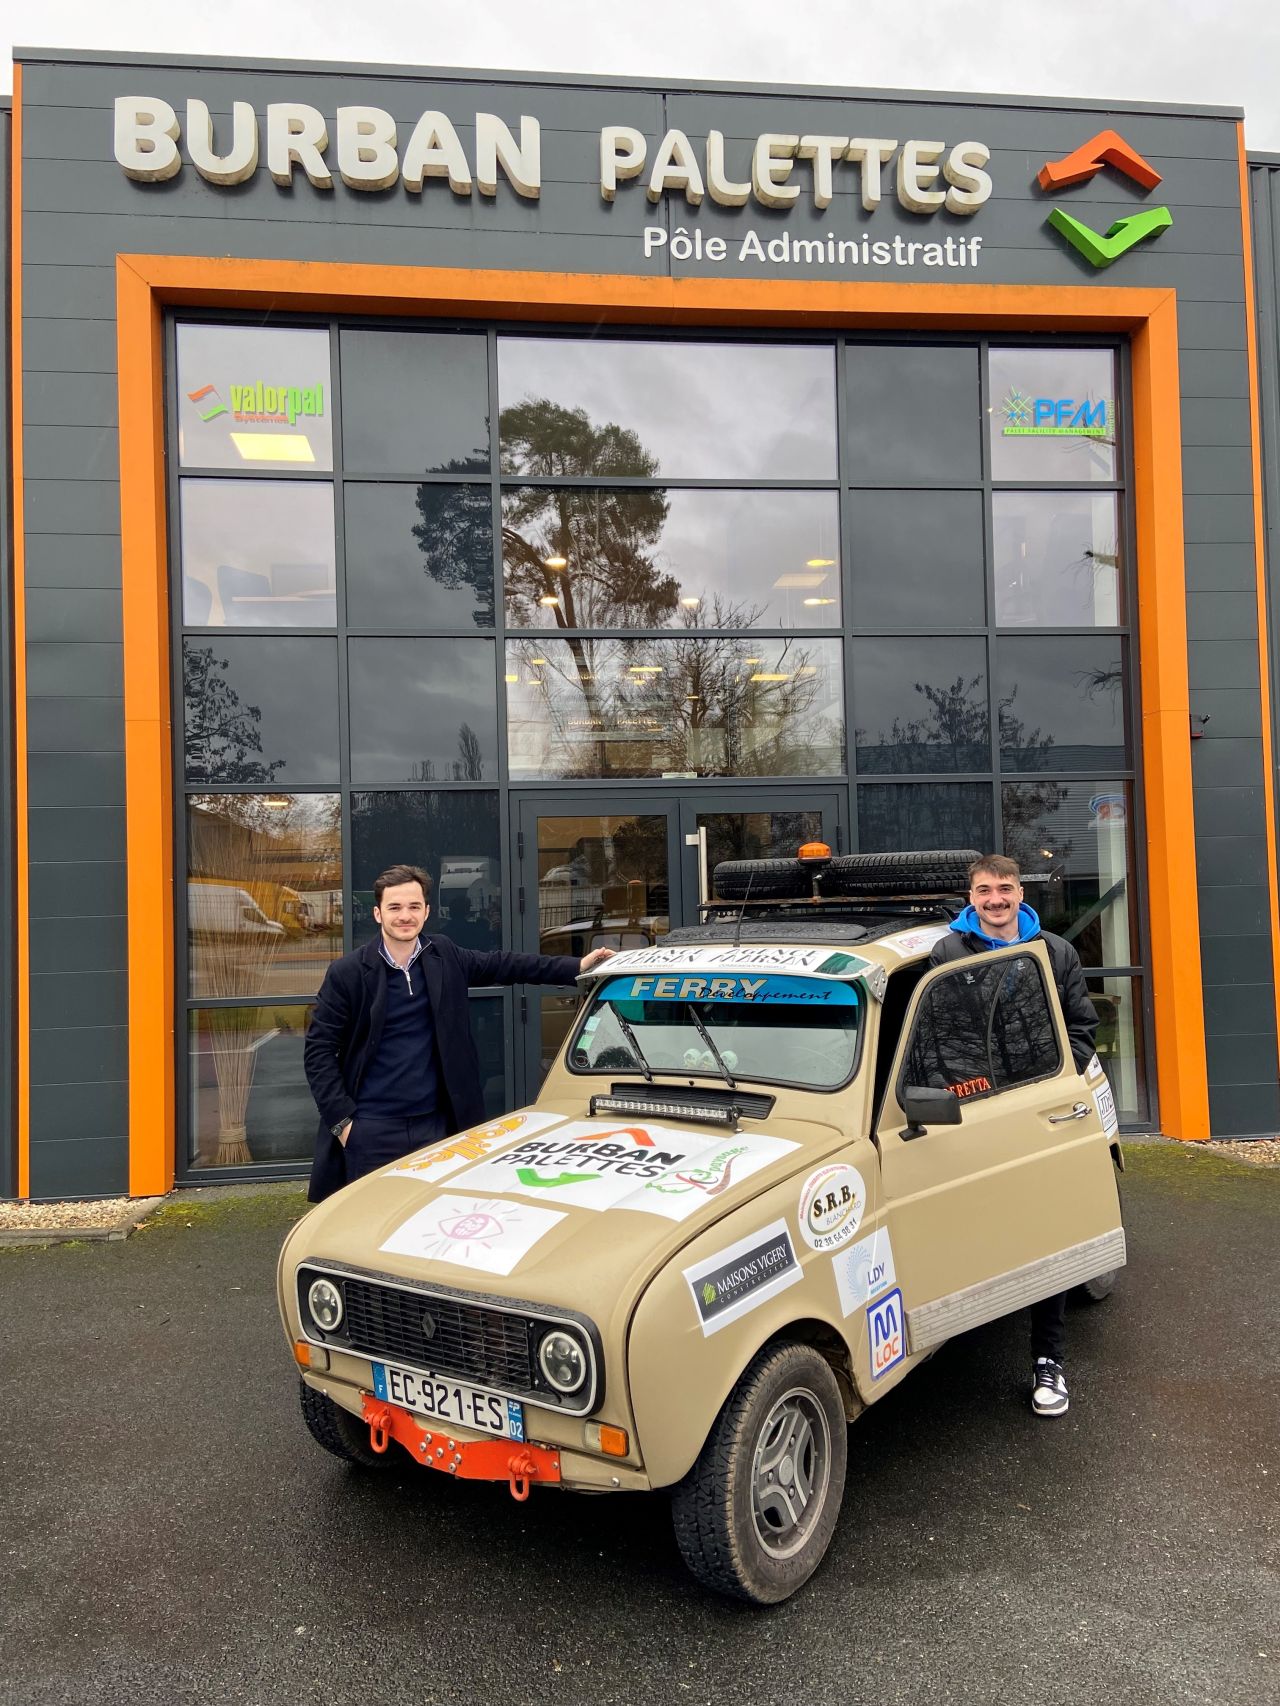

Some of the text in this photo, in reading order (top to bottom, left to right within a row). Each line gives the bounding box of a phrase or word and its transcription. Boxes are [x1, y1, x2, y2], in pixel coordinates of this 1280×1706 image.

[115, 96, 993, 214] BURBAN PALETTES
[643, 226, 983, 267] Pôle Administratif
[229, 380, 323, 425] valorpal
[1034, 399, 1106, 428] PFM
[630, 977, 768, 999] FERRY
[491, 1153, 667, 1178] PALETTES
[512, 1141, 686, 1166] BURBAN
[813, 1185, 856, 1218] S.R.B.
[814, 1238, 824, 1248] 02
[833, 1231, 843, 1242] 64
[841, 1225, 851, 1236] 98
[717, 1243, 787, 1295] MAISONS VIGERY
[867, 1262, 885, 1286] LDY
[874, 1303, 898, 1347] M
[876, 1336, 899, 1369] LOC
[378, 1384, 383, 1393] F
[389, 1369, 504, 1431] EC-921-ES
[509, 1419, 523, 1438] 02
